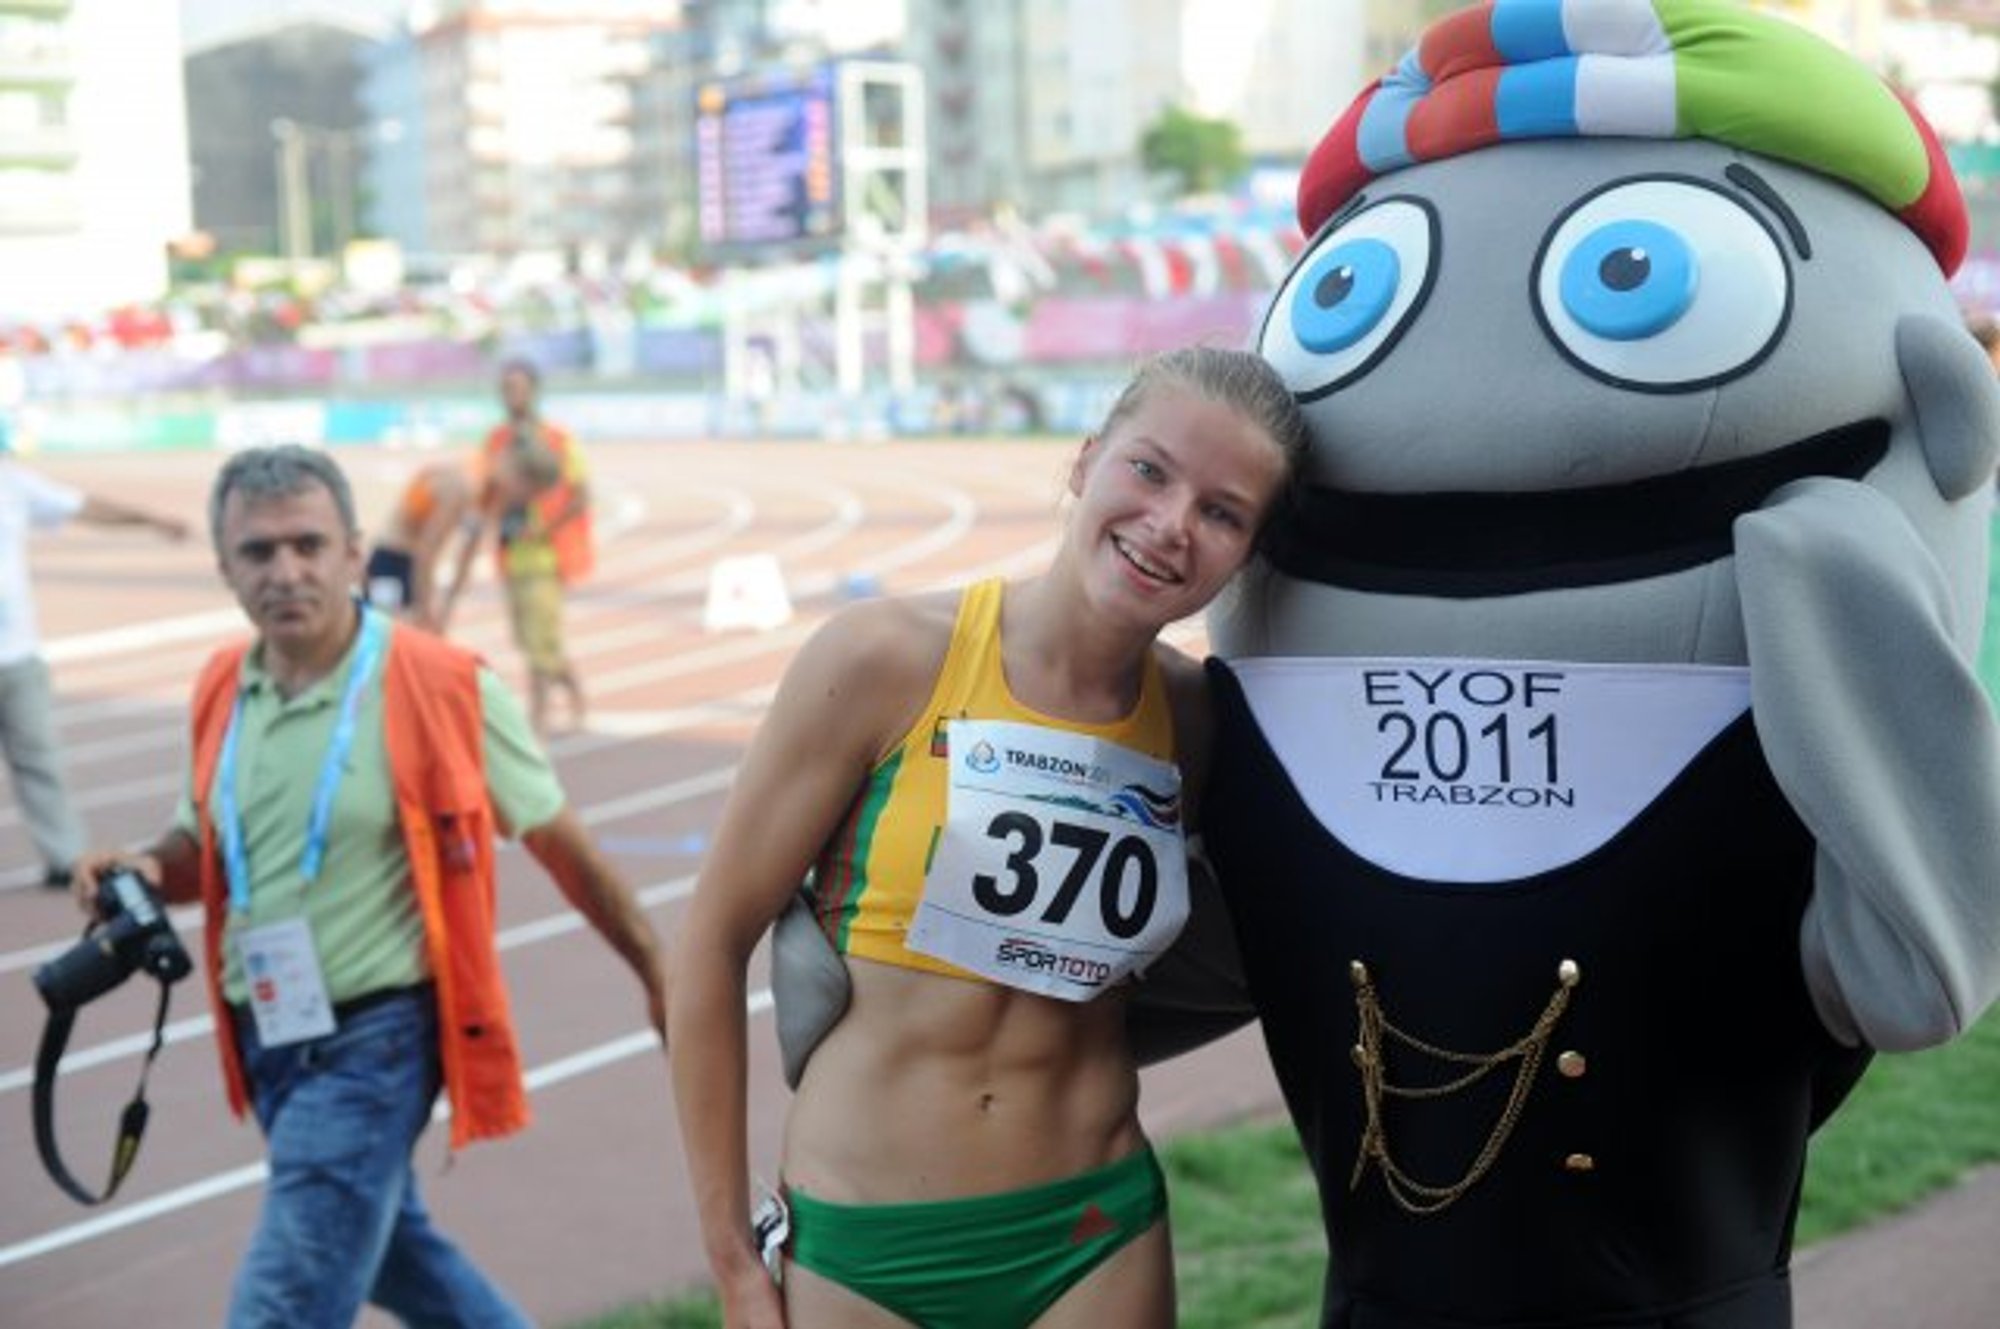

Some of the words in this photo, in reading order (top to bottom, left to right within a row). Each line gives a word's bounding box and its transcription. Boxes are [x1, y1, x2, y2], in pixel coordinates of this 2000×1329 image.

[1363, 669, 1565, 708] EYOF
[1005, 748, 1086, 777] TRABZON
[1378, 710, 1557, 784] 2011
[1368, 782, 1575, 808] TRABZON
[972, 811, 1158, 939] 370
